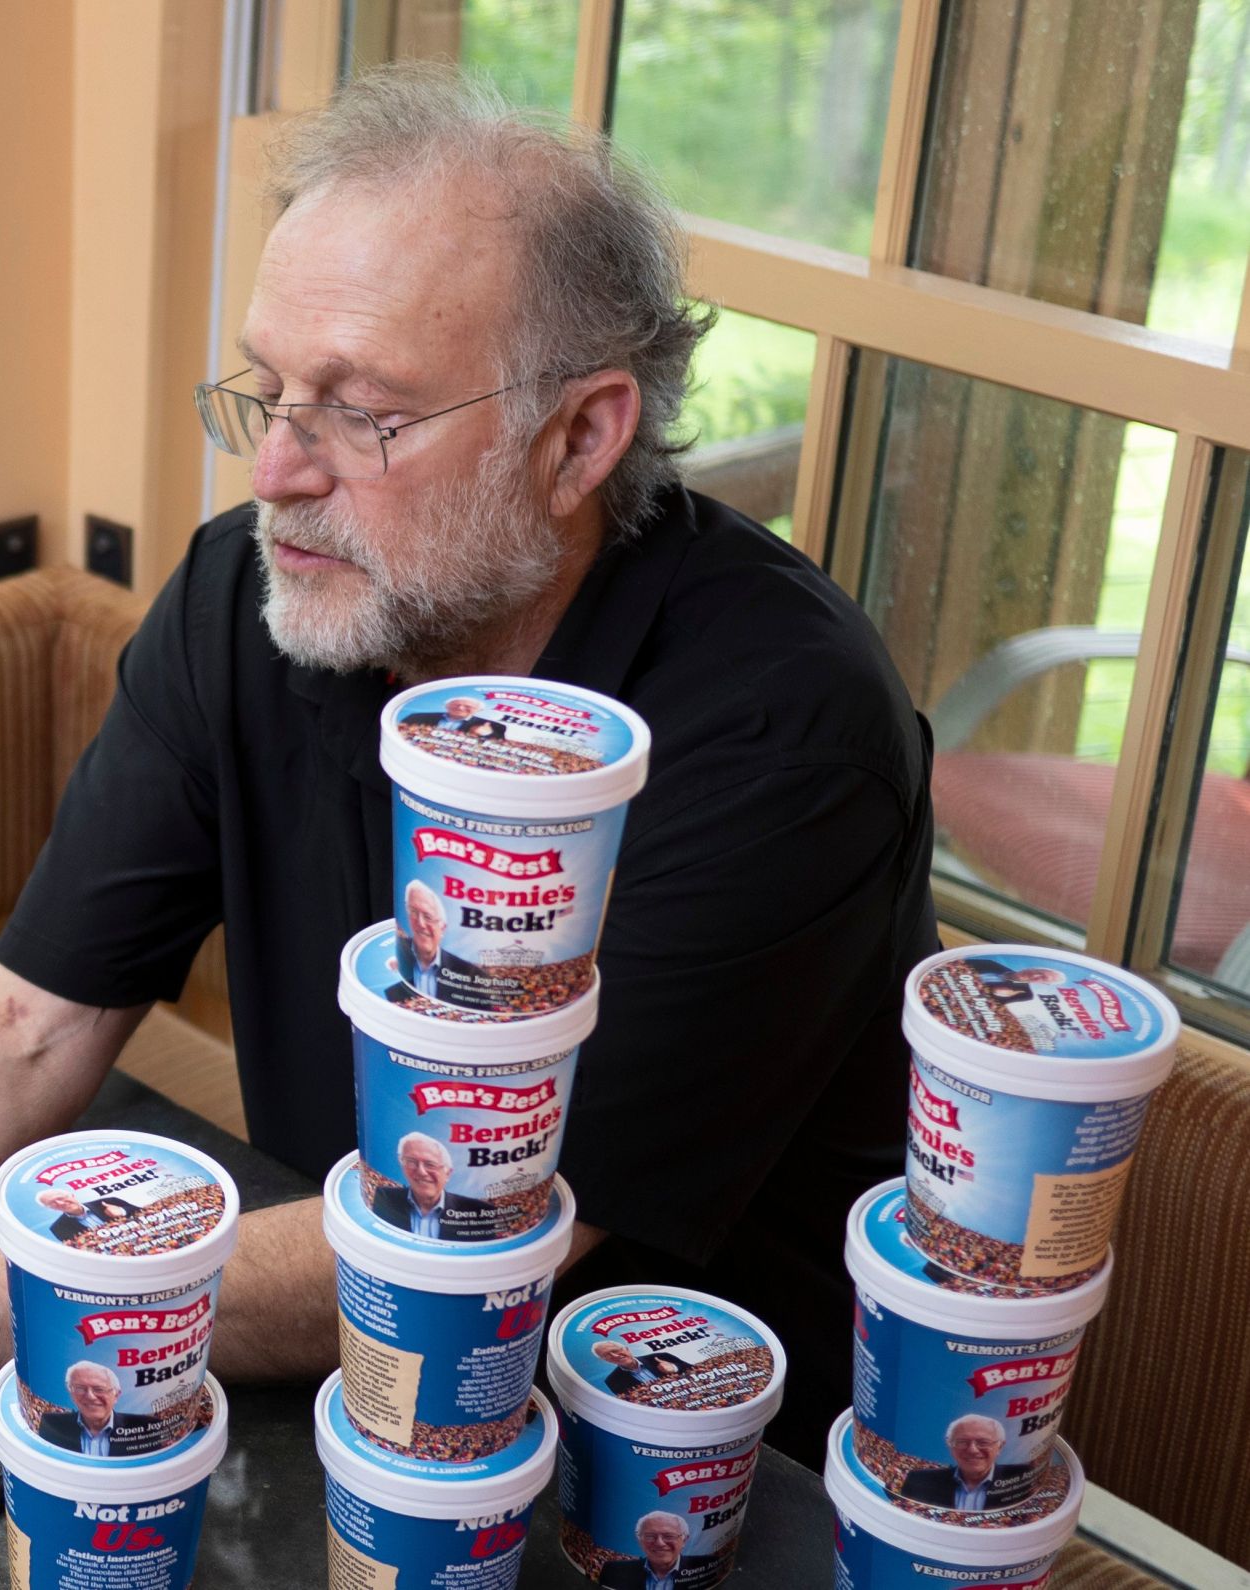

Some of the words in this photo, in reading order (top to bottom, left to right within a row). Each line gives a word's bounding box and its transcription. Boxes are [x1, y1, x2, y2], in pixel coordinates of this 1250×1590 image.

[494, 704, 600, 733] Bernie's
[499, 715, 573, 736] Back!
[399, 791, 464, 828] VERMONT'S
[466, 820, 524, 836] FINEST
[525, 820, 593, 836] SENATOR
[418, 832, 486, 864] Ben's
[489, 853, 552, 876] Best
[443, 875, 576, 909] Bernie's
[460, 906, 557, 932] Back!
[441, 967, 471, 982] Open
[474, 976, 519, 988] Joyfully
[1087, 976, 1119, 1005] Ben's
[960, 975, 980, 996] Open
[975, 997, 1002, 1032] Joyfully
[1038, 994, 1077, 1035] Back!
[1058, 987, 1104, 1041] Bernie's
[389, 1051, 474, 1077] VERMONT'S
[477, 1064, 526, 1077] FINEST
[421, 1086, 495, 1106] Ben's
[498, 1083, 549, 1109] Best
[932, 1067, 991, 1104] SENATOR
[917, 1080, 949, 1122] Best
[450, 1106, 561, 1143] Bernie's
[468, 1132, 549, 1167] Back!
[39, 1163, 82, 1181] Ben's
[84, 1154, 122, 1167] Best
[67, 1158, 158, 1191] Bernie's
[92, 1170, 159, 1197] Back!
[97, 1221, 140, 1238] Open
[139, 1202, 198, 1224] Joyfully
[446, 1209, 477, 1219] Open
[479, 1205, 518, 1217] Joyfully
[54, 1288, 139, 1306] VERMONT'S
[142, 1286, 188, 1304] FINEST
[482, 1284, 531, 1312] Not
[89, 1314, 158, 1335] Ben's
[162, 1302, 205, 1329] Best
[597, 1315, 635, 1331] Ben's
[638, 1309, 673, 1320] Best
[620, 1315, 709, 1345] Bernie's
[645, 1328, 710, 1352] Back!
[946, 1341, 1037, 1355] VERMONT'S
[135, 1345, 203, 1388] Back!
[650, 1378, 690, 1393] Open
[691, 1363, 747, 1381] Joyfully
[982, 1361, 1050, 1386] Ben's
[116, 1427, 144, 1435] Open
[147, 1414, 180, 1431] Joyfully
[632, 1445, 713, 1459] VERMONT'S
[666, 1464, 726, 1485] Ben's
[994, 1476, 1020, 1487] Open
[73, 1501, 128, 1523] Not
[136, 1499, 185, 1521] me.
[986, 1512, 1005, 1520] PINT
[92, 1523, 165, 1551] Us.
[57, 1559, 67, 1567] the
[70, 1563, 82, 1572] big
[84, 1567, 122, 1576] chocolate
[59, 1553, 77, 1563] Take
[79, 1559, 98, 1568] back
[68, 1548, 105, 1562] Eating
[62, 1576, 88, 1586] spread
[71, 1571, 89, 1580] Then
[130, 1570, 157, 1581] around
[681, 1566, 705, 1576] Open
[912, 1563, 1000, 1580] VERMONT'S
